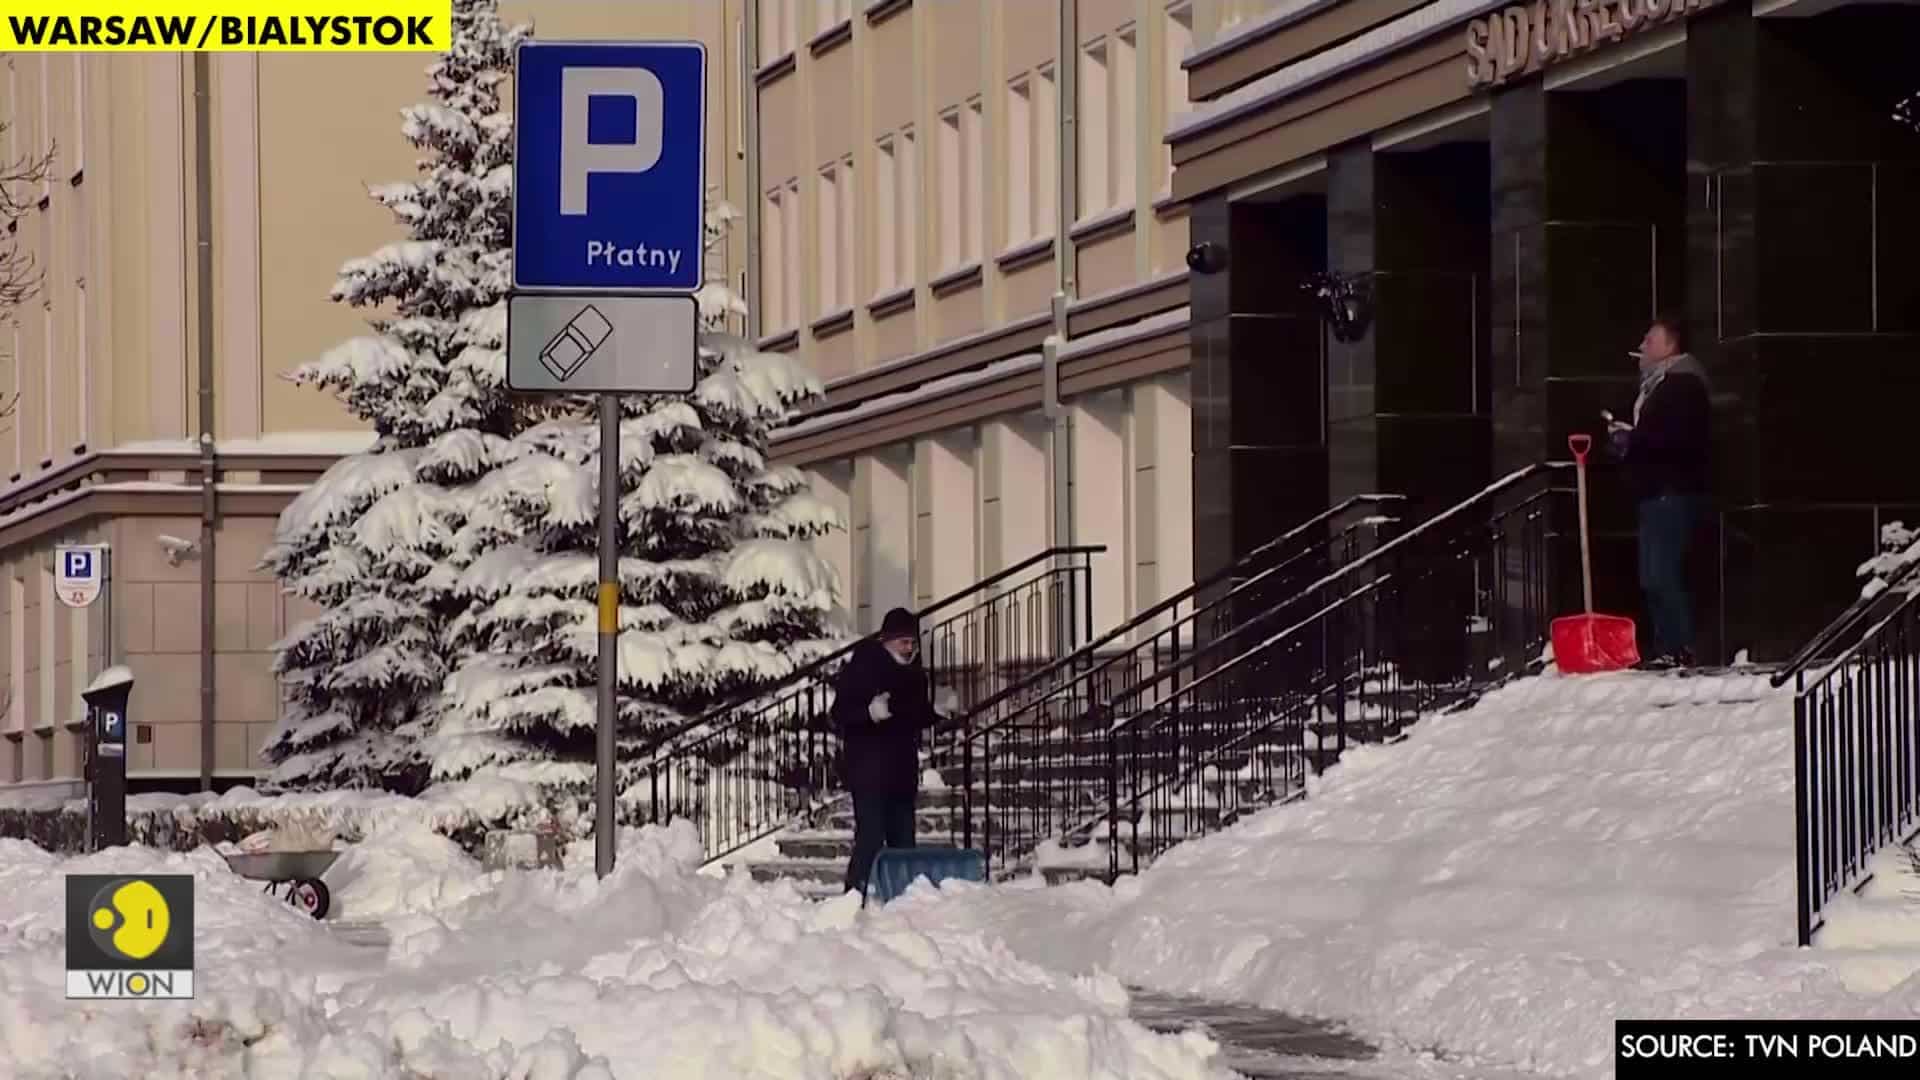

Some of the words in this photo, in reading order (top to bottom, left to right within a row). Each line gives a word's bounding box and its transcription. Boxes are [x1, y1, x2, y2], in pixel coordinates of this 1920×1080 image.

[561, 67, 663, 214] P
[587, 240, 681, 274] Płatny
[71, 554, 86, 576] P
[105, 712, 119, 732] P
